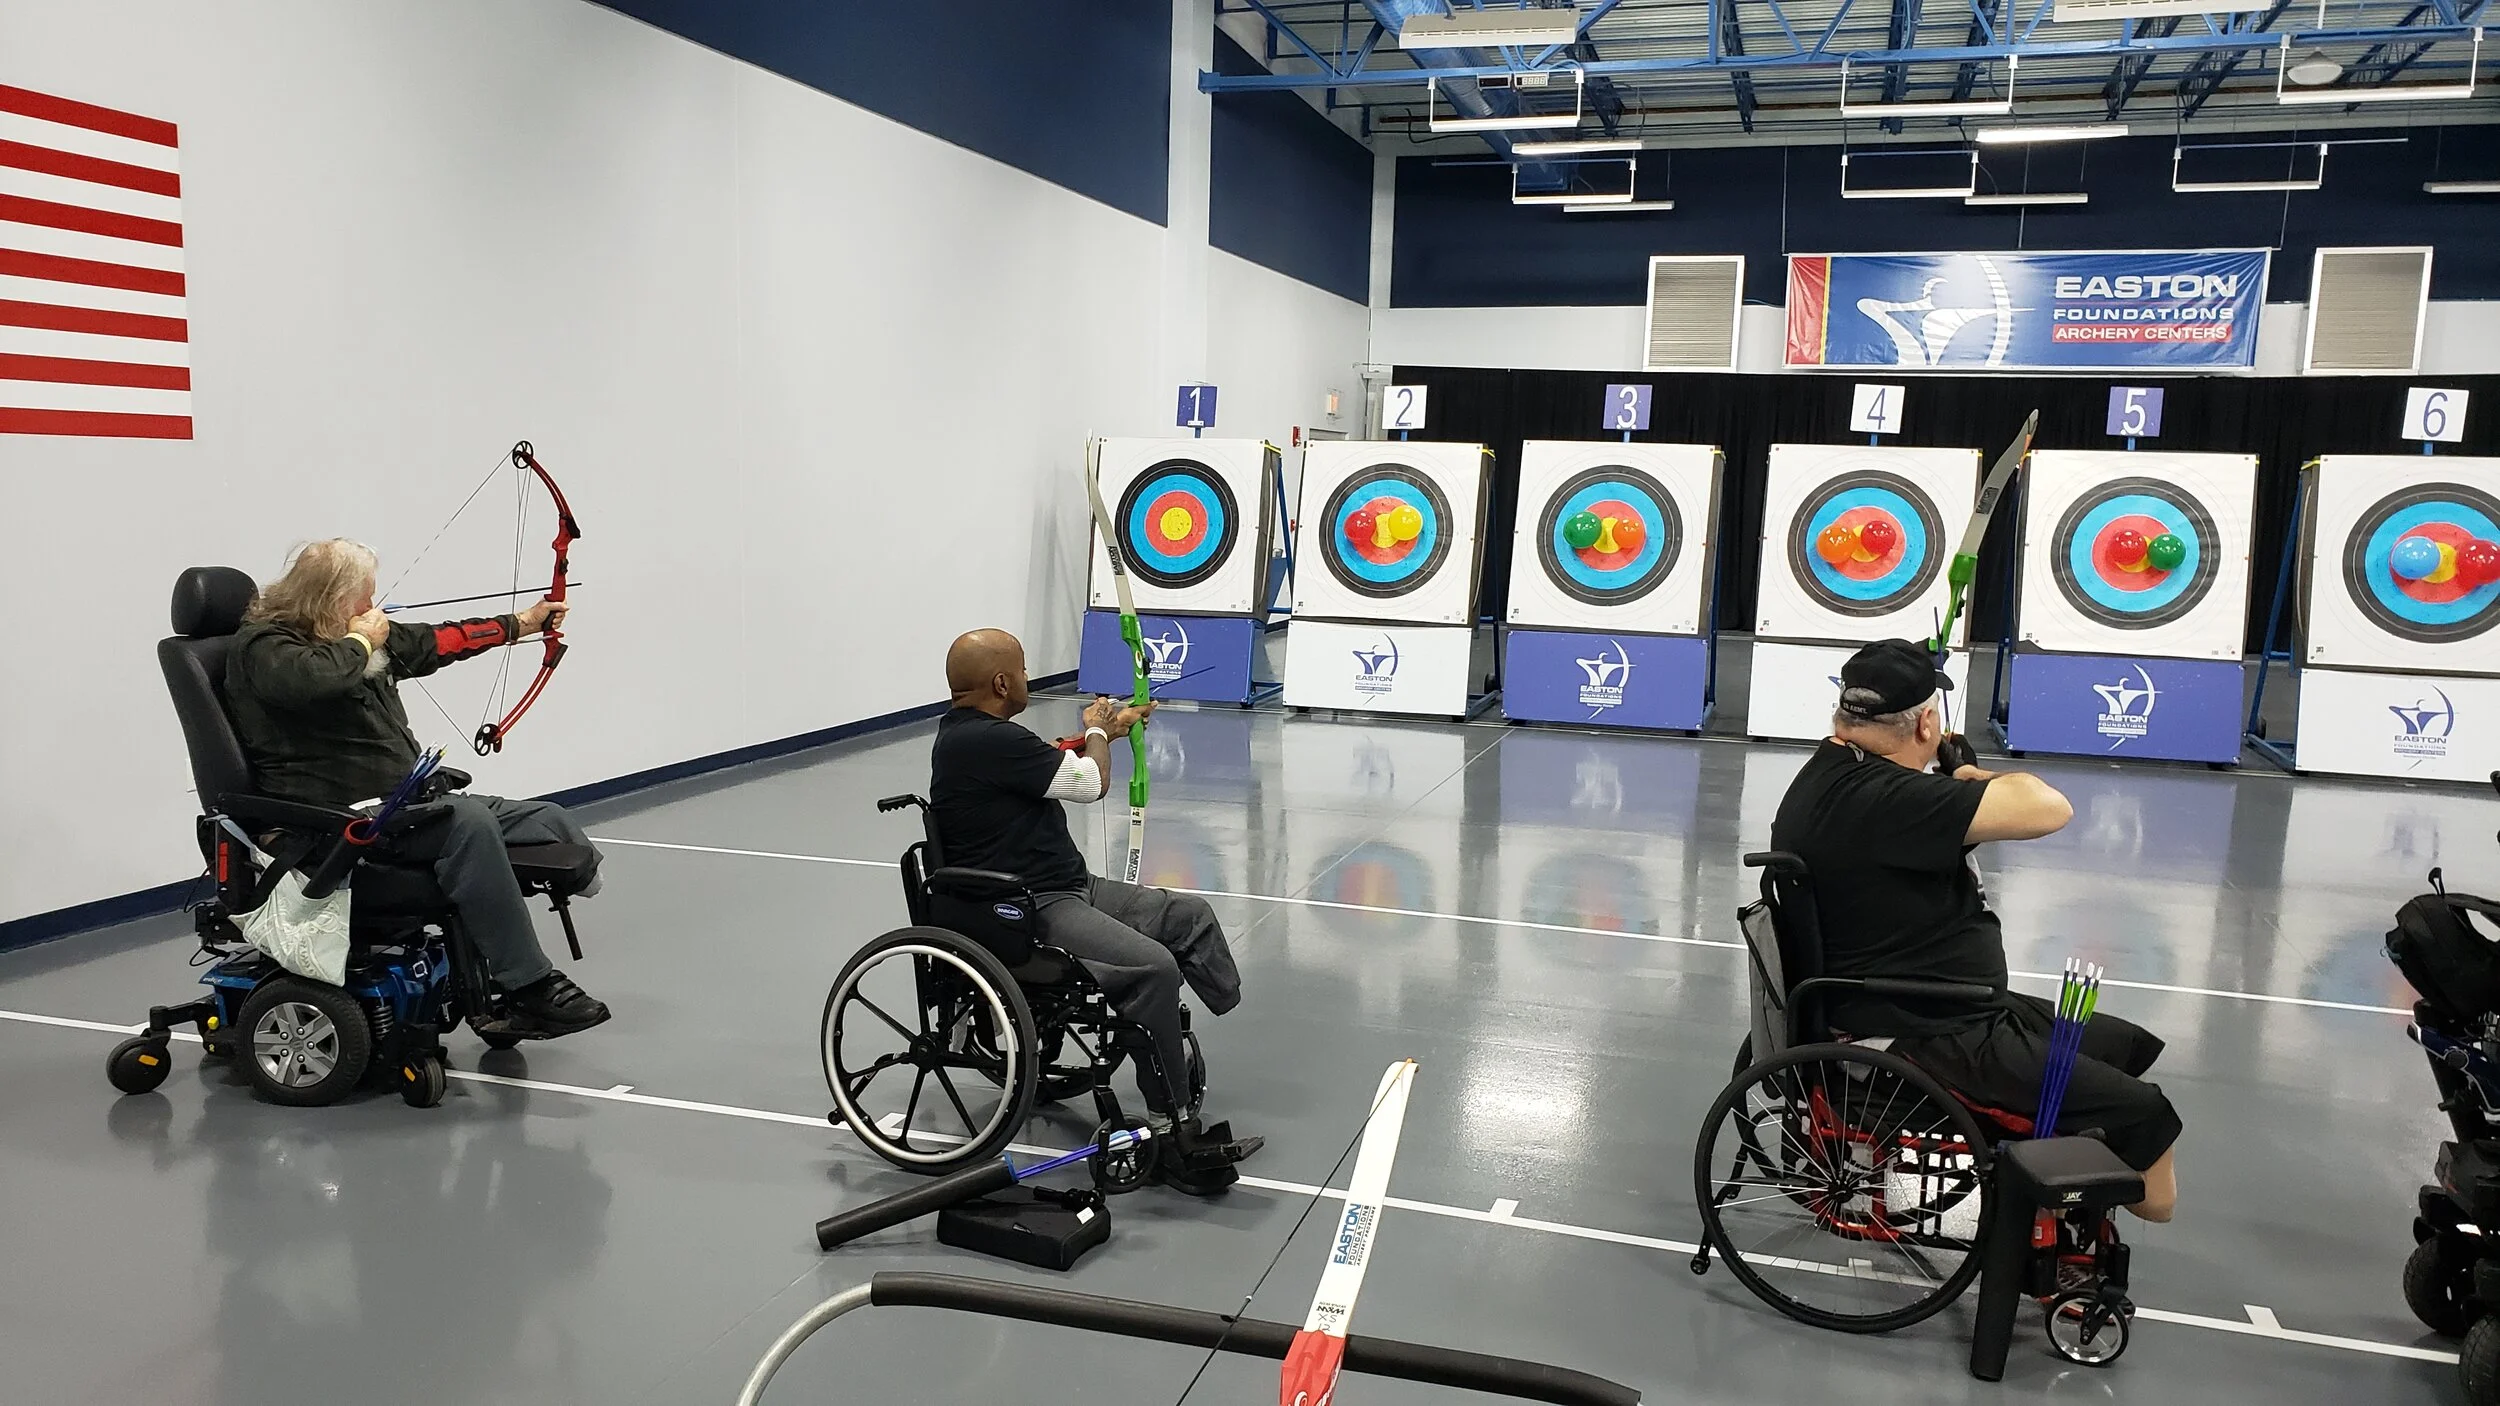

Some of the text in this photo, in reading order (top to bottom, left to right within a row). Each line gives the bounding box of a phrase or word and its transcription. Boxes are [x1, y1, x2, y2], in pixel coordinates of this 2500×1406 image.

[2055, 275, 2238, 299] EASTON
[2053, 307, 2234, 320] FOUNDATIONS
[2055, 326, 2228, 340] ARCHERY CENTERS
[1188, 386, 1204, 425] 1
[1396, 388, 1413, 427] 2
[1616, 386, 1638, 427] 3
[1866, 387, 1886, 430] 4
[2122, 388, 2146, 434] 5
[2422, 391, 2448, 438] 6
[1580, 685, 1623, 694] EASTON
[2098, 713, 2148, 723] EASTON
[2394, 735, 2447, 744] EASTON
[1333, 1203, 1362, 1265] EASTON
[1348, 1205, 1370, 1266] FOUNDATIONS
